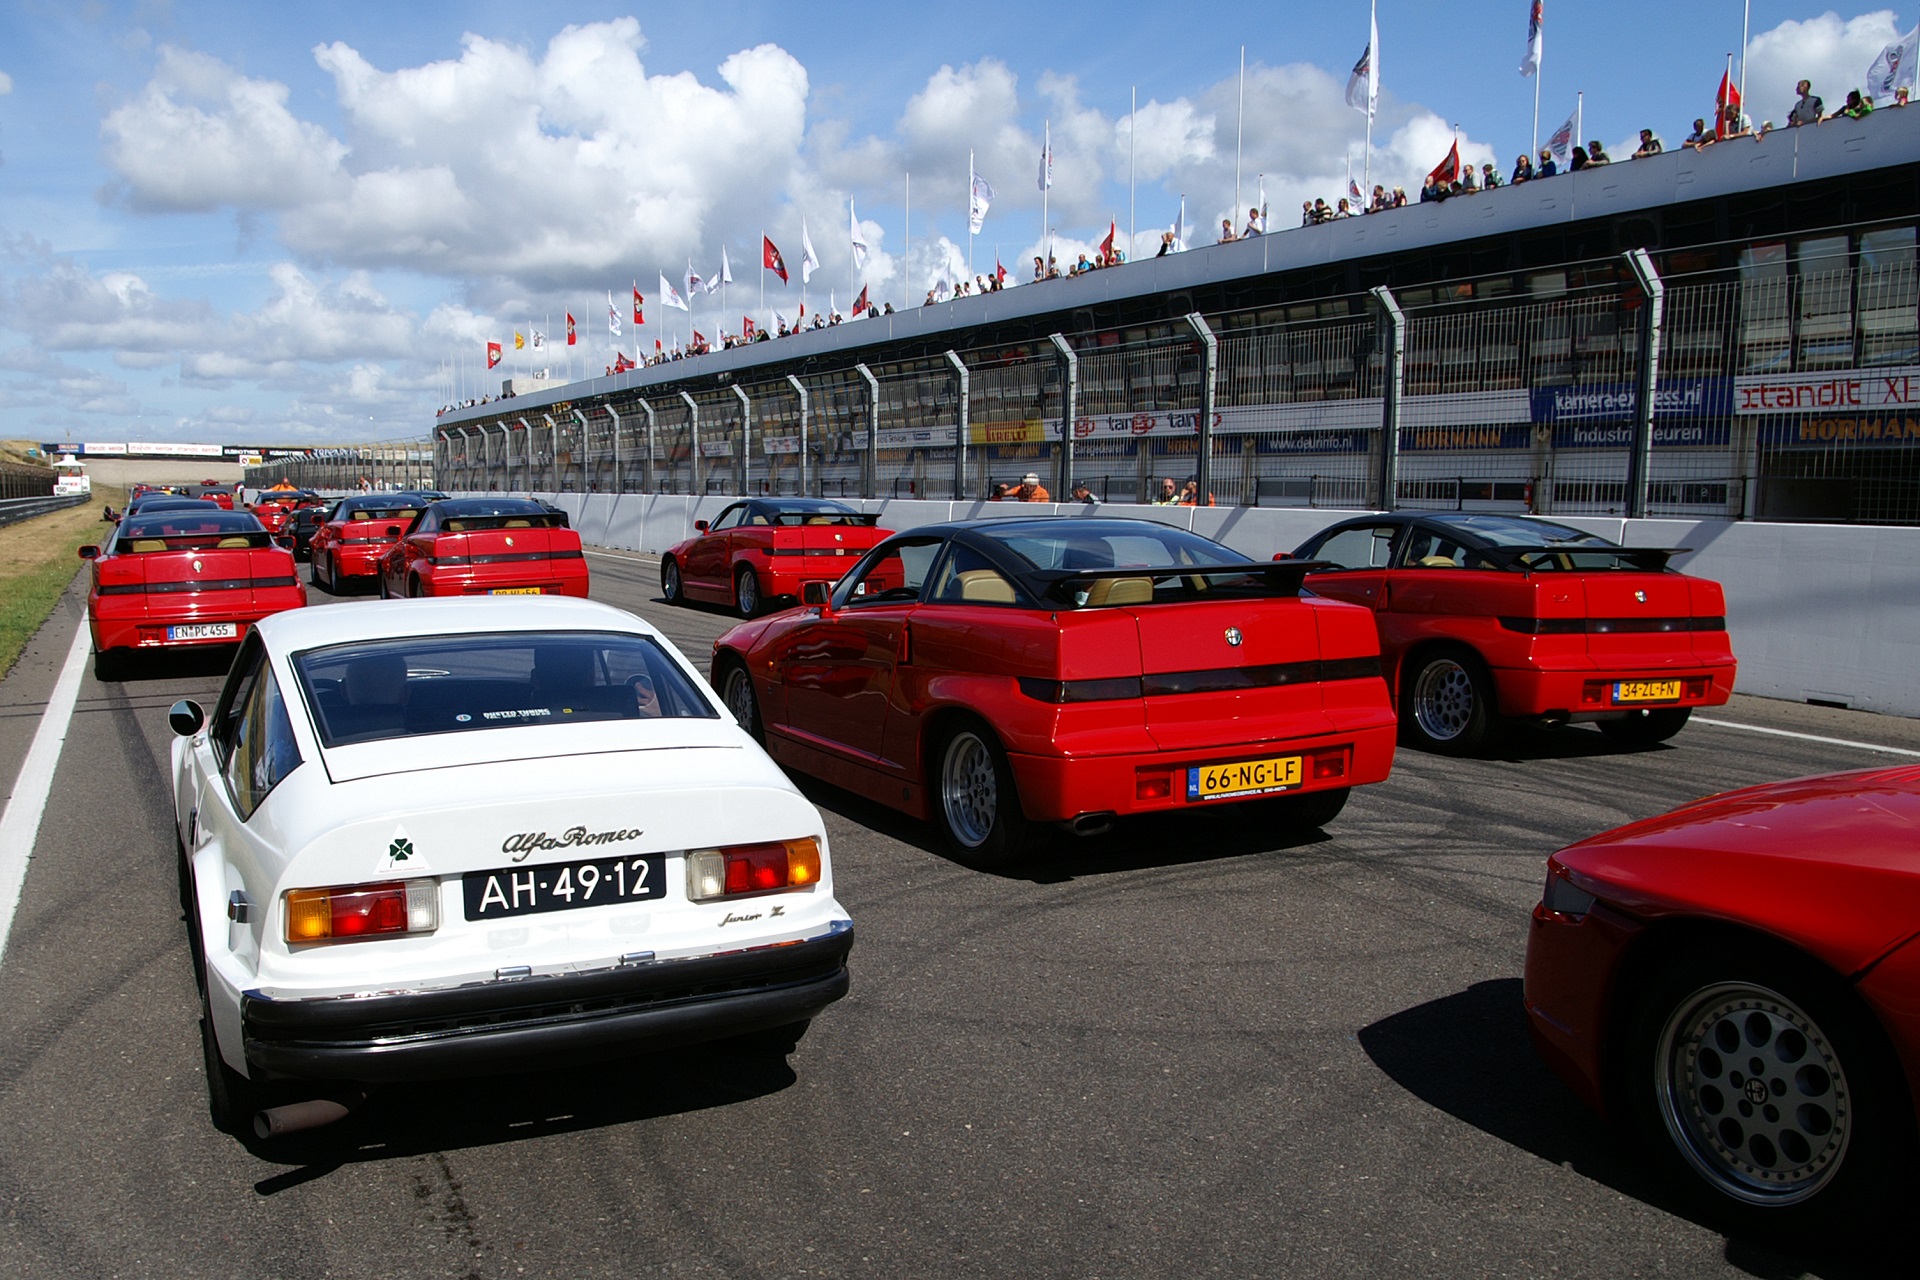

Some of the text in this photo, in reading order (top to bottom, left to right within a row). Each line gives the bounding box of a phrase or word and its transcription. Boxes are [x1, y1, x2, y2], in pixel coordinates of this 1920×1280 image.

[1555, 384, 1701, 410] kamera-exess.nl
[985, 421, 1026, 442] PIRELLI
[1168, 411, 1222, 432] tano
[1574, 426, 1702, 443] Industrieuren
[210, 625, 228, 635] 455
[1623, 681, 1675, 697] 34-ZL-FN
[1205, 761, 1295, 790] 66-NG-LF
[502, 825, 643, 862] Alfa Romeo
